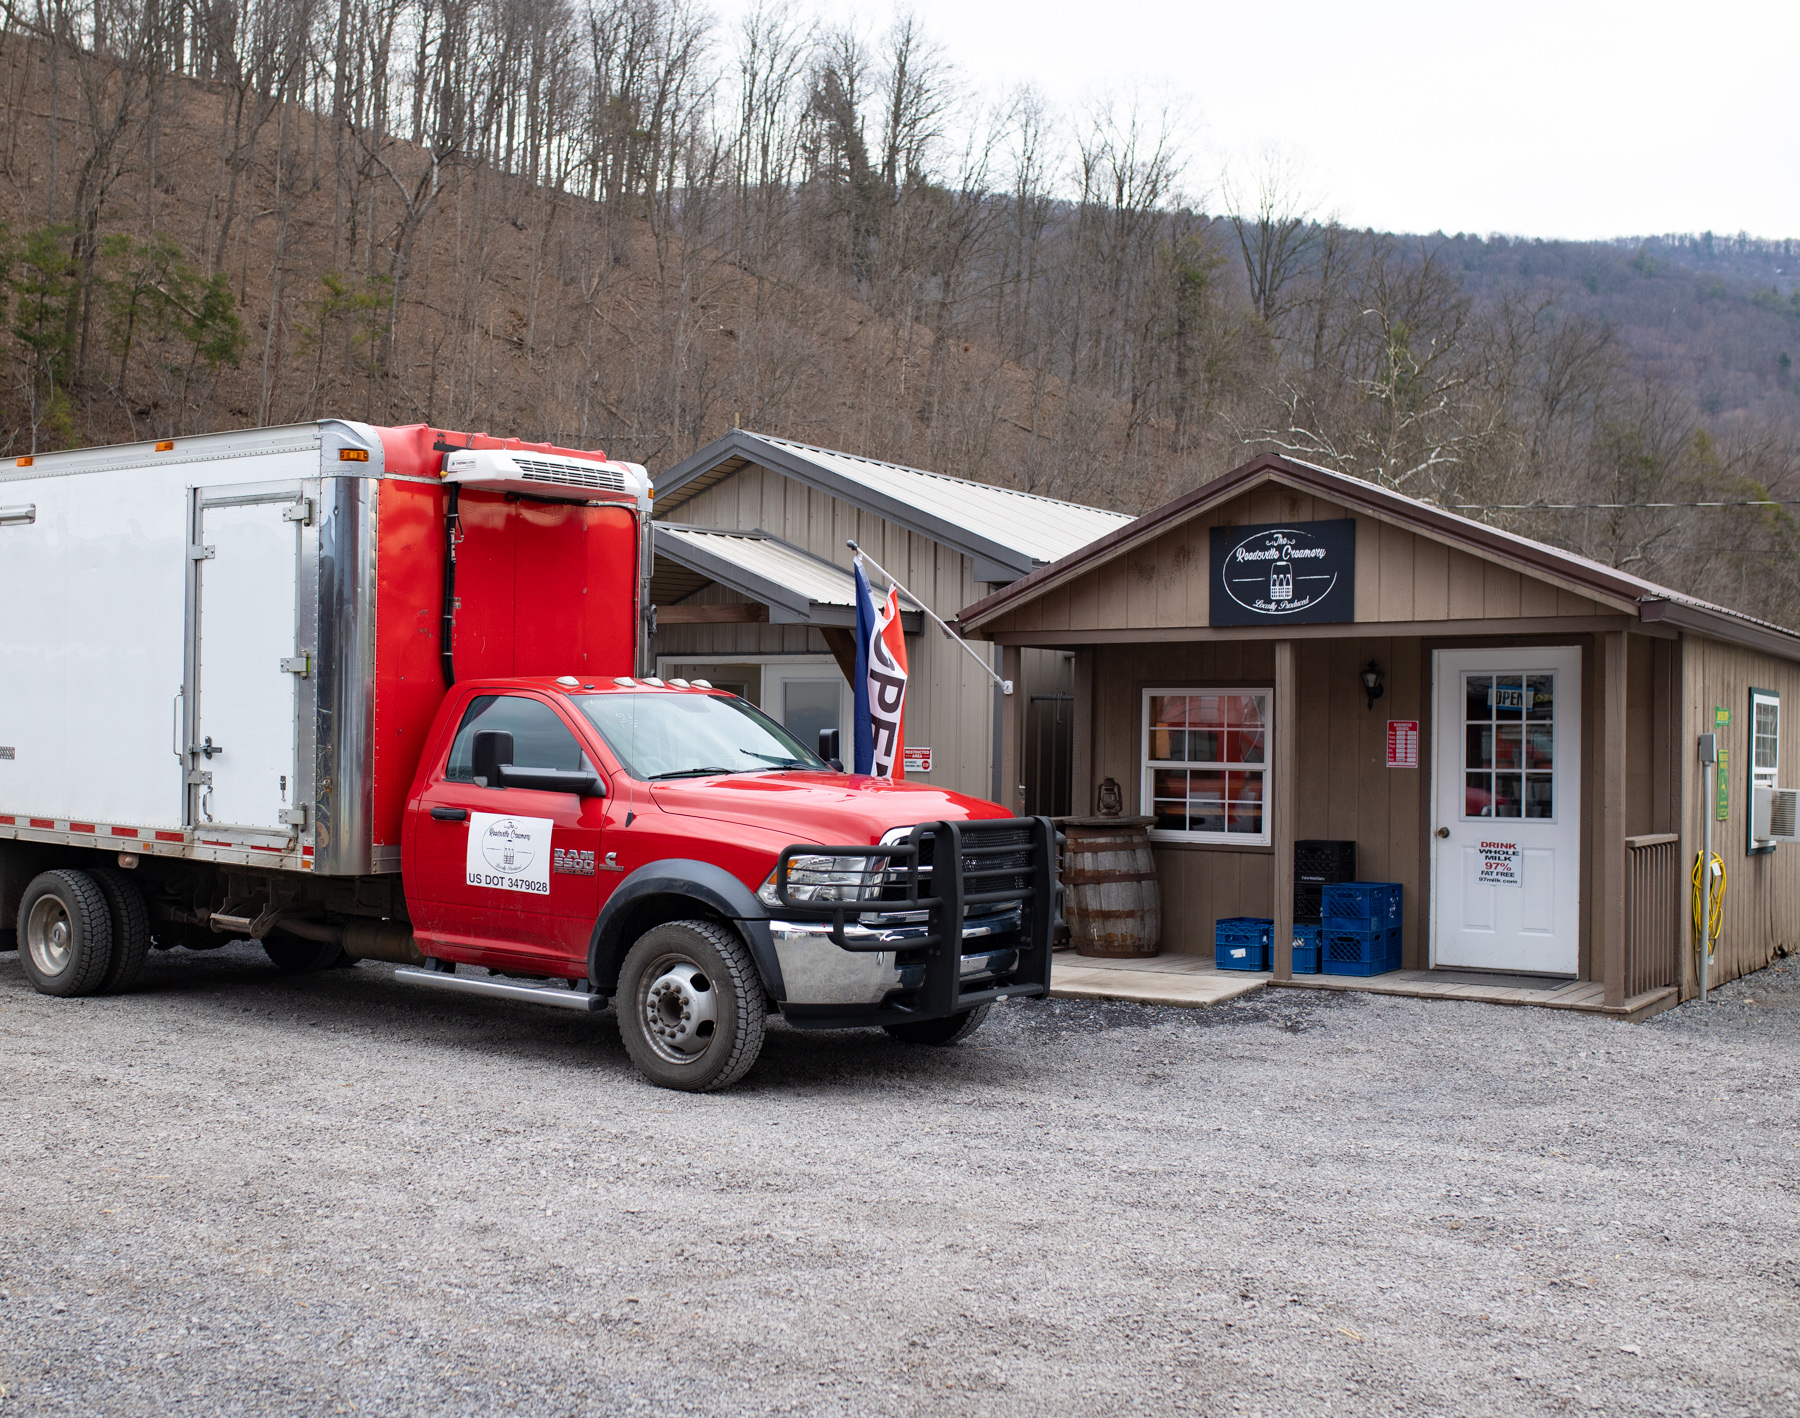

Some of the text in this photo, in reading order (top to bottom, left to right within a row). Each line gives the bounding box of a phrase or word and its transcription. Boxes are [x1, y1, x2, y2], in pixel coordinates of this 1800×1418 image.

[1273, 533, 1287, 546] The
[1282, 545, 1326, 559] Creamery
[1253, 595, 1310, 611] Locally Produced
[1480, 841, 1517, 850] DRINK
[554, 848, 595, 860] RAM
[1478, 848, 1520, 856] WHOLE
[554, 857, 594, 869] 5500
[1485, 861, 1512, 871] 97%
[469, 873, 548, 892] US DOT 3479028
